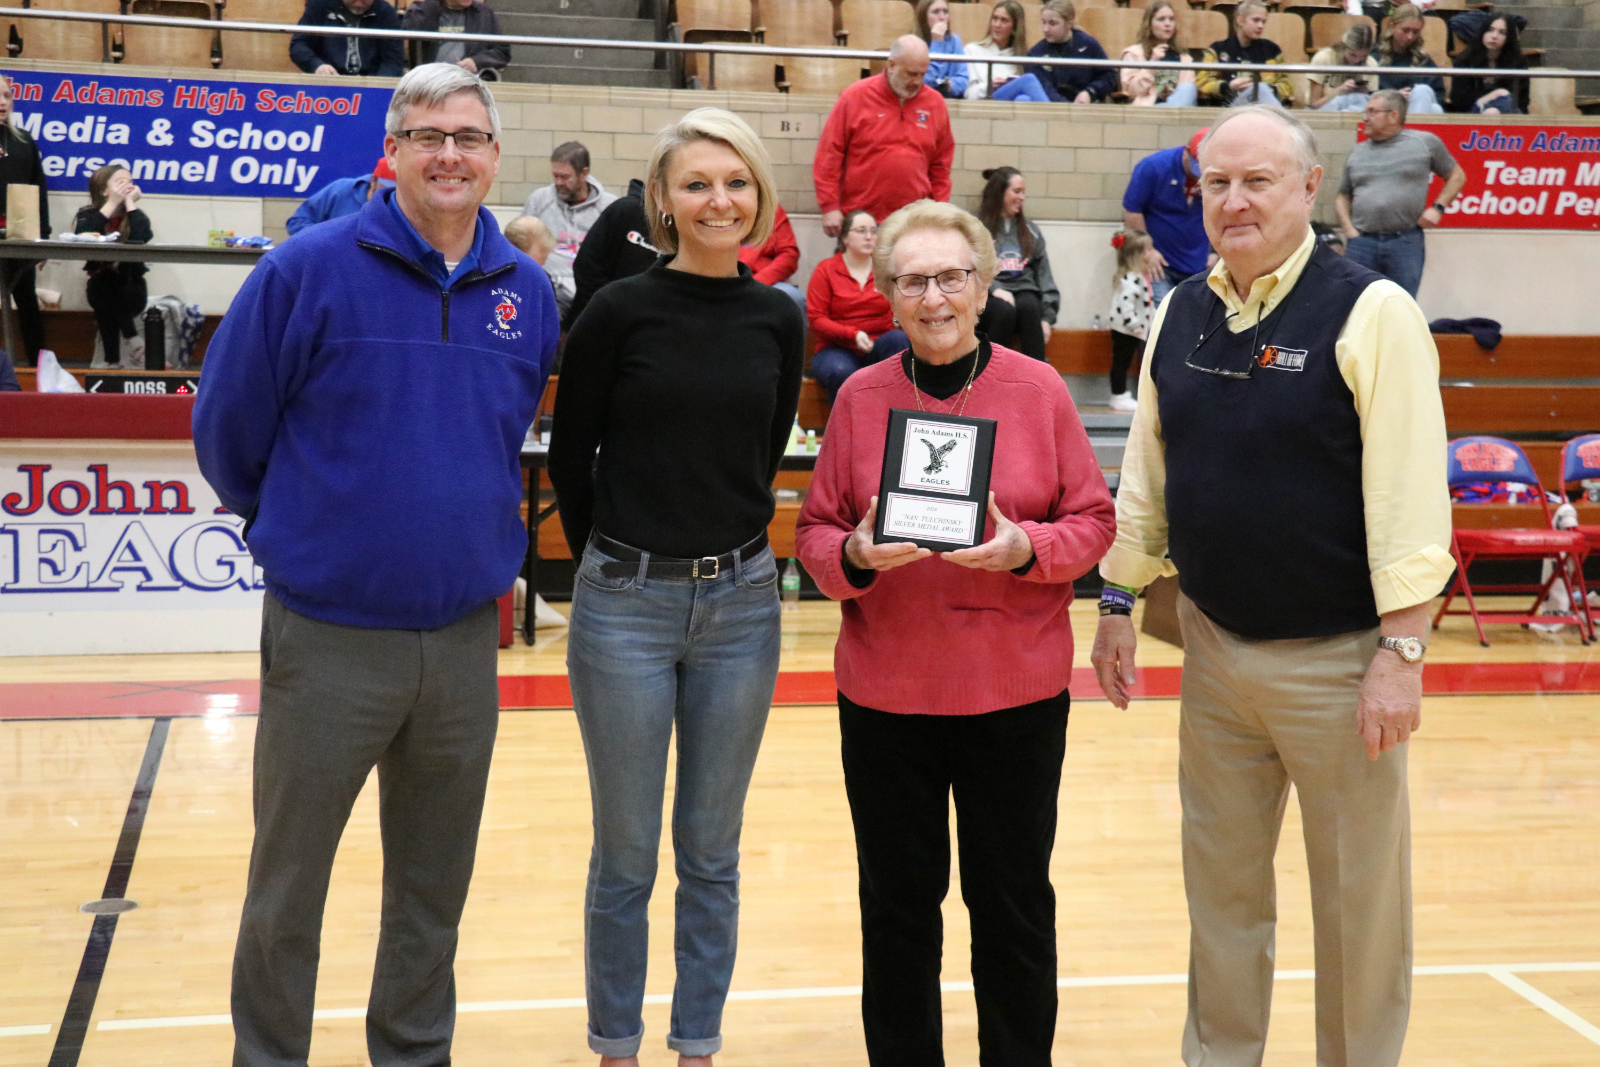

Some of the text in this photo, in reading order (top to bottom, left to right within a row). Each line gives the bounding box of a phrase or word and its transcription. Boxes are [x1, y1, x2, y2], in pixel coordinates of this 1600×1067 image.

[7, 77, 362, 116] hn Adams High School
[11, 111, 325, 152] Media & School
[1460, 131, 1522, 151] John
[40, 154, 319, 192] ersnnel Only
[1483, 160, 1566, 186] Team
[491, 288, 522, 303] ADAMS
[486, 322, 522, 339] EAGLES
[913, 427, 930, 435] John
[931, 429, 954, 437] Adams
[1, 464, 195, 516] John
[920, 477, 951, 486] EAGLES
[894, 520, 916, 528] SILVER
[917, 523, 940, 531] MEDAL
[921, 515, 963, 526] TULCHINSKY
